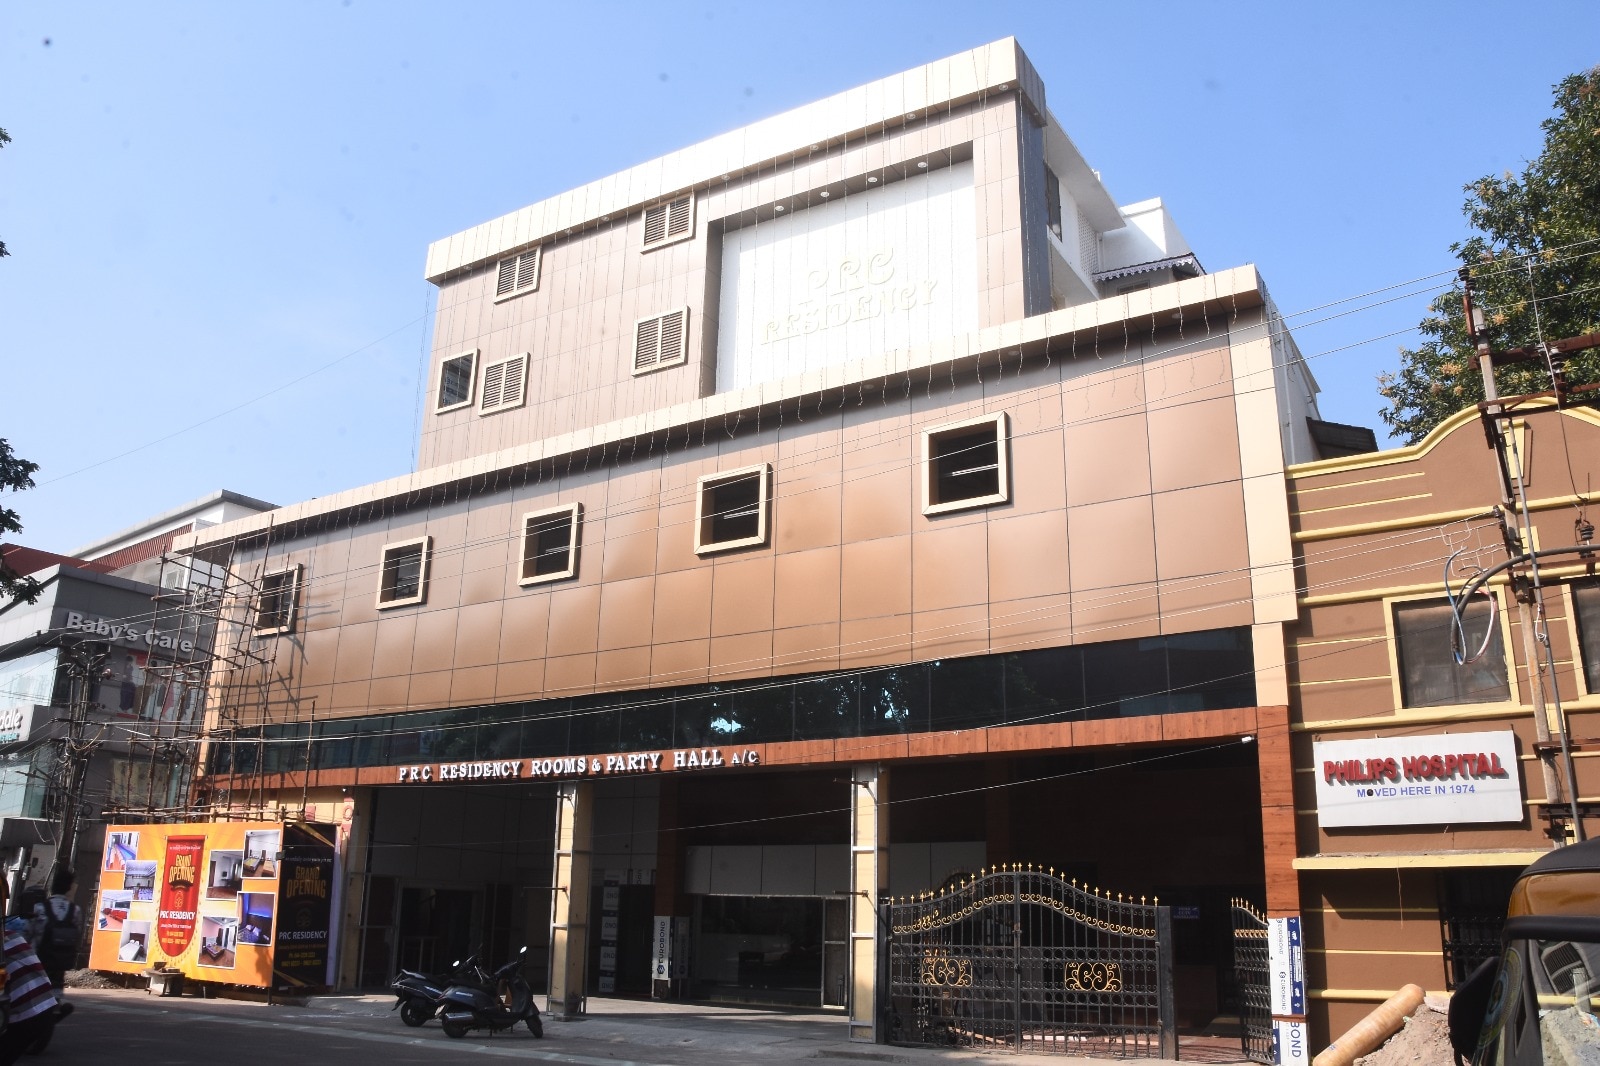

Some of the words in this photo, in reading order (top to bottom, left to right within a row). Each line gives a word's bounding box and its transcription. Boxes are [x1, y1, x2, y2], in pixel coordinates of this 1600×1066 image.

[760, 279, 939, 345] RESIDENCY
[66, 611, 139, 642] Baby's
[145, 631, 194, 653] Care
[398, 766, 431, 781] PRC
[440, 761, 521, 779] RESIDENCY
[531, 757, 587, 775] ROOMS
[592, 758, 602, 772] &
[606, 752, 662, 771] PARTY
[673, 749, 725, 768] HALL
[731, 749, 760, 764] A/C
[1323, 756, 1398, 783] PHILIPS
[1402, 752, 1506, 779] HOSPITAL
[1400, 786, 1432, 796] HERE
[1434, 785, 1446, 794] IN
[1449, 784, 1475, 794] 1974
[295, 866, 320, 880] GRAND
[286, 879, 327, 898] OPENING
[169, 911, 196, 920] RESIDENCY
[278, 931, 291, 940] PRC
[292, 930, 328, 940] RESIDENCY
